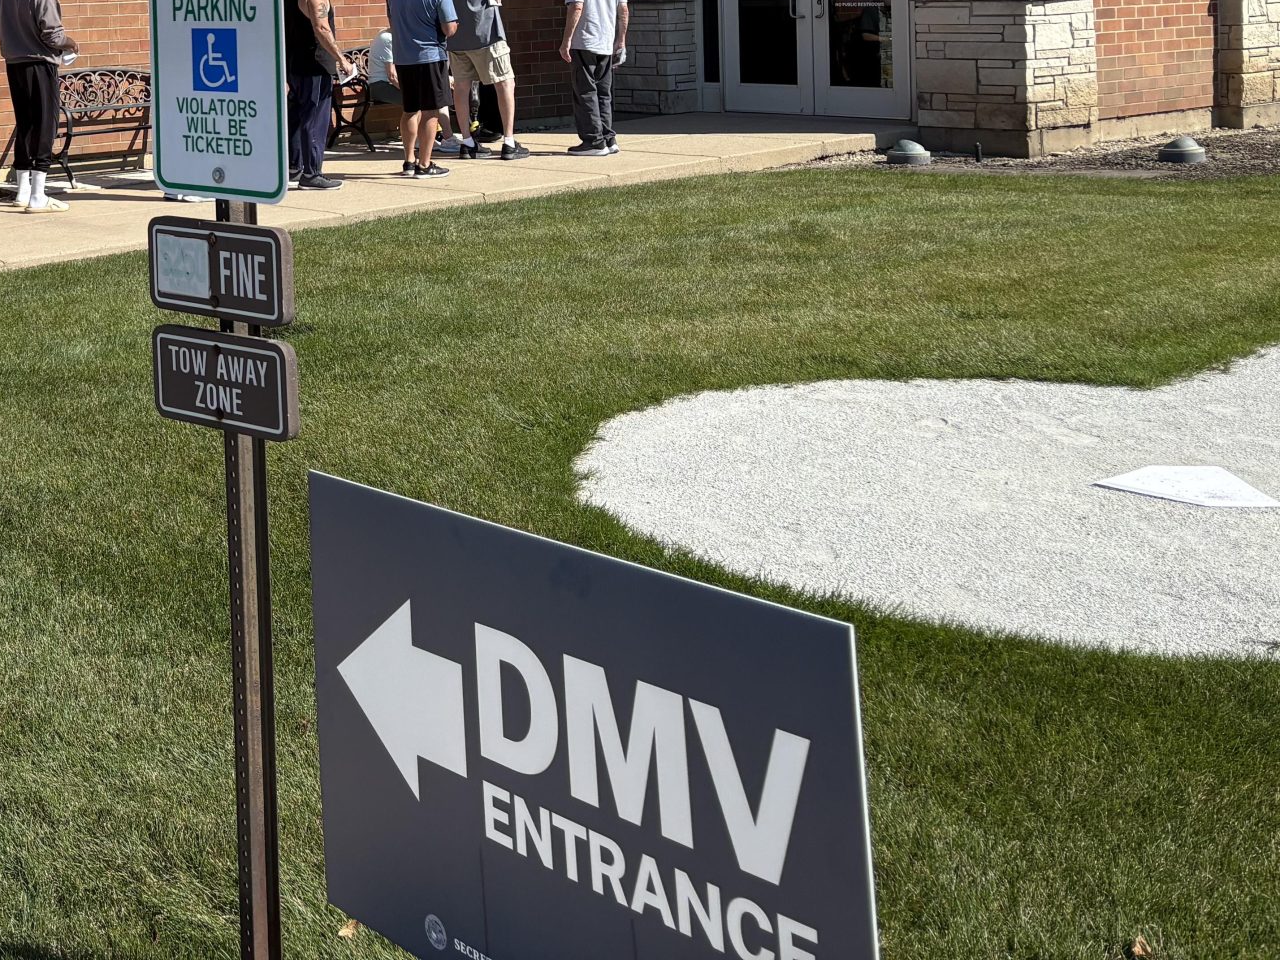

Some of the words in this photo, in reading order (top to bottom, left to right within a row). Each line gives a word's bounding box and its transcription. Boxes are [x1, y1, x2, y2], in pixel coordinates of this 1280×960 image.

[176, 96, 257, 118] VIOLATORS
[186, 116, 221, 135] WILL
[229, 119, 248, 137] BE
[183, 134, 253, 157] TICKETED
[219, 250, 268, 301] FINE
[168, 344, 207, 377] TOW
[216, 353, 269, 388] AWAY
[194, 380, 243, 416] ZONE
[474, 621, 811, 886] DMV
[482, 780, 819, 960] ENTRANCE
